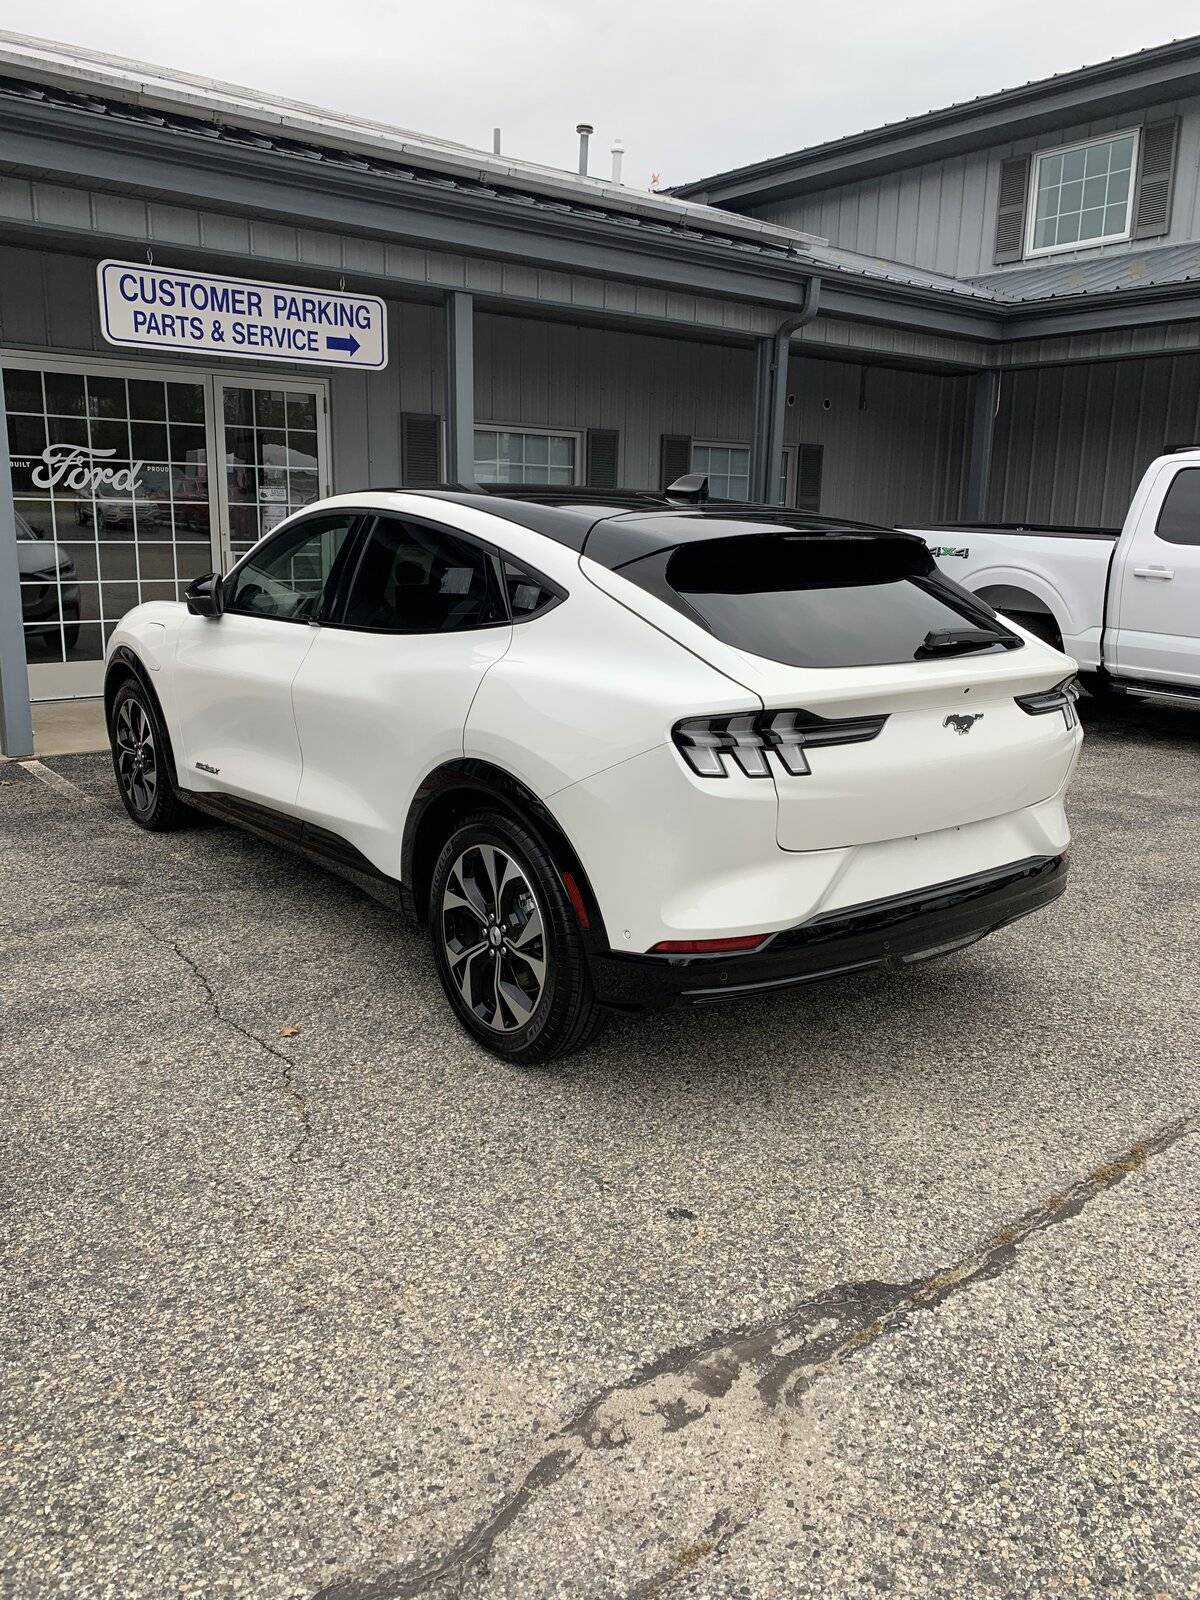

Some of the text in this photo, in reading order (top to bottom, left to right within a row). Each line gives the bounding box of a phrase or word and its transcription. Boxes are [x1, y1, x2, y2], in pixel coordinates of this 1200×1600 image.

[119, 273, 371, 330] CUSTOMER PARKING
[133, 310, 319, 352] PARTS & SERVICE
[31, 443, 144, 492] Ford
[146, 465, 169, 473] PROUD
